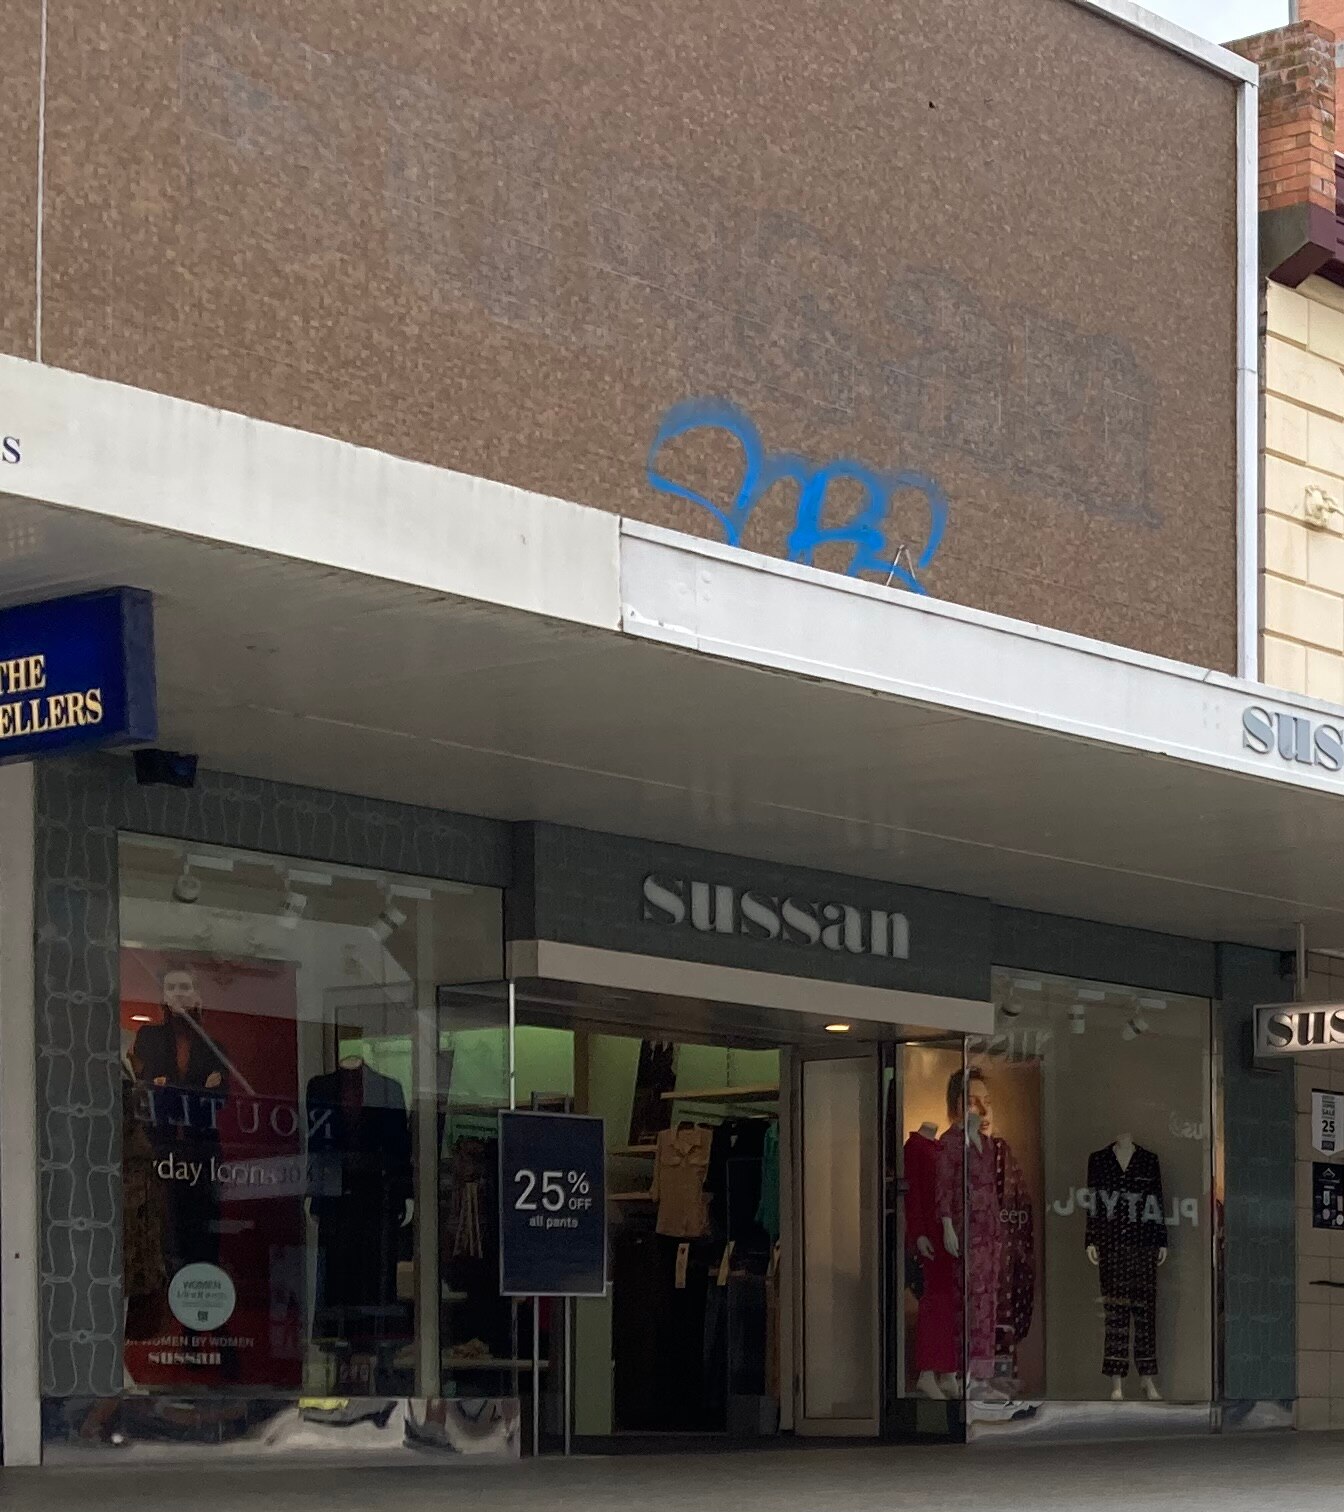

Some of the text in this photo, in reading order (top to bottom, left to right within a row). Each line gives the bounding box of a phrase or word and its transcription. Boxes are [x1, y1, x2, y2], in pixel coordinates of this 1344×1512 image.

[643, 874, 909, 959] sussan
[1322, 1119, 1335, 1133] 25
[568, 1198, 592, 1211] OFF
[529, 1215, 579, 1230] all pants
